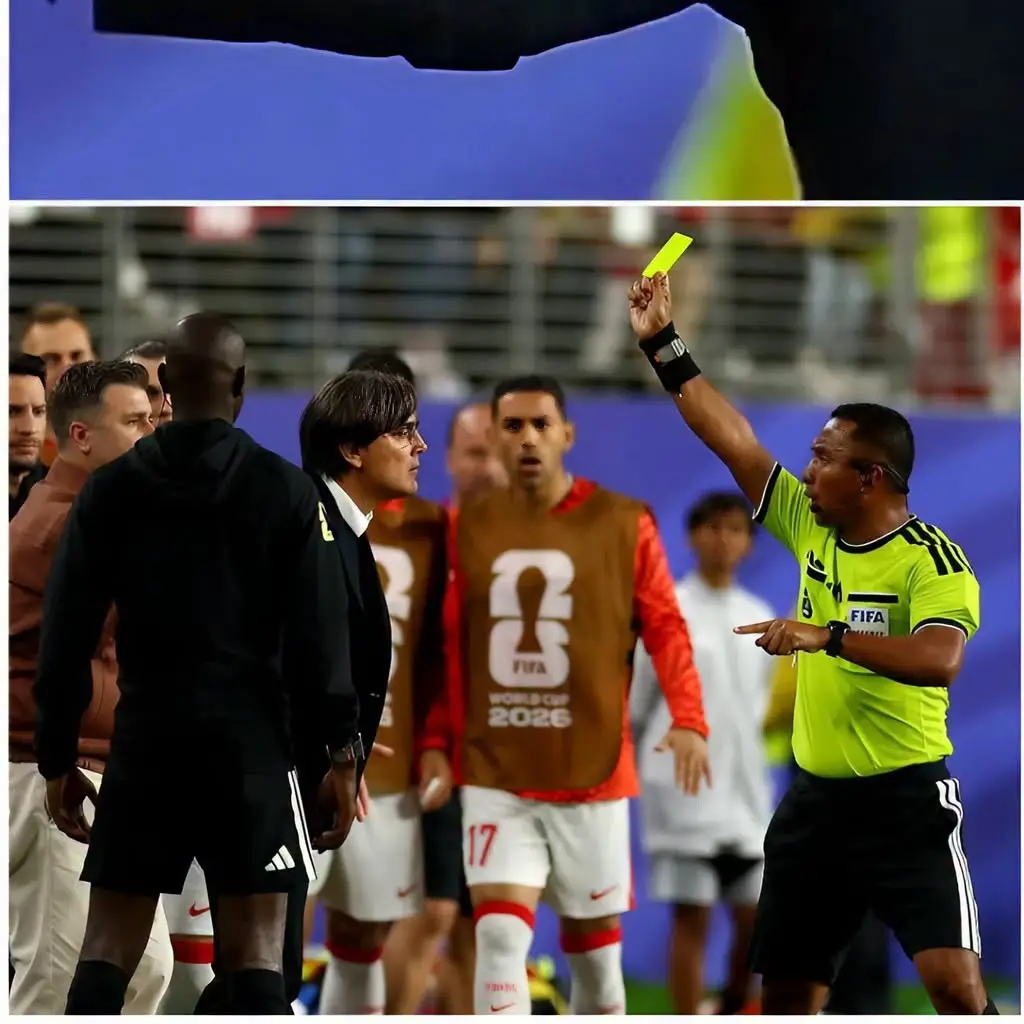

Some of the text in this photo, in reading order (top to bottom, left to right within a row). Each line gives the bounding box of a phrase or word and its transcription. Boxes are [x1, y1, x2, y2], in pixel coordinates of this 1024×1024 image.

[851, 610, 885, 624] FIFA
[513, 659, 547, 675] FIFA
[488, 692, 570, 707] WORLD CUP
[487, 707, 573, 728] 2026
[468, 823, 498, 867] 17
